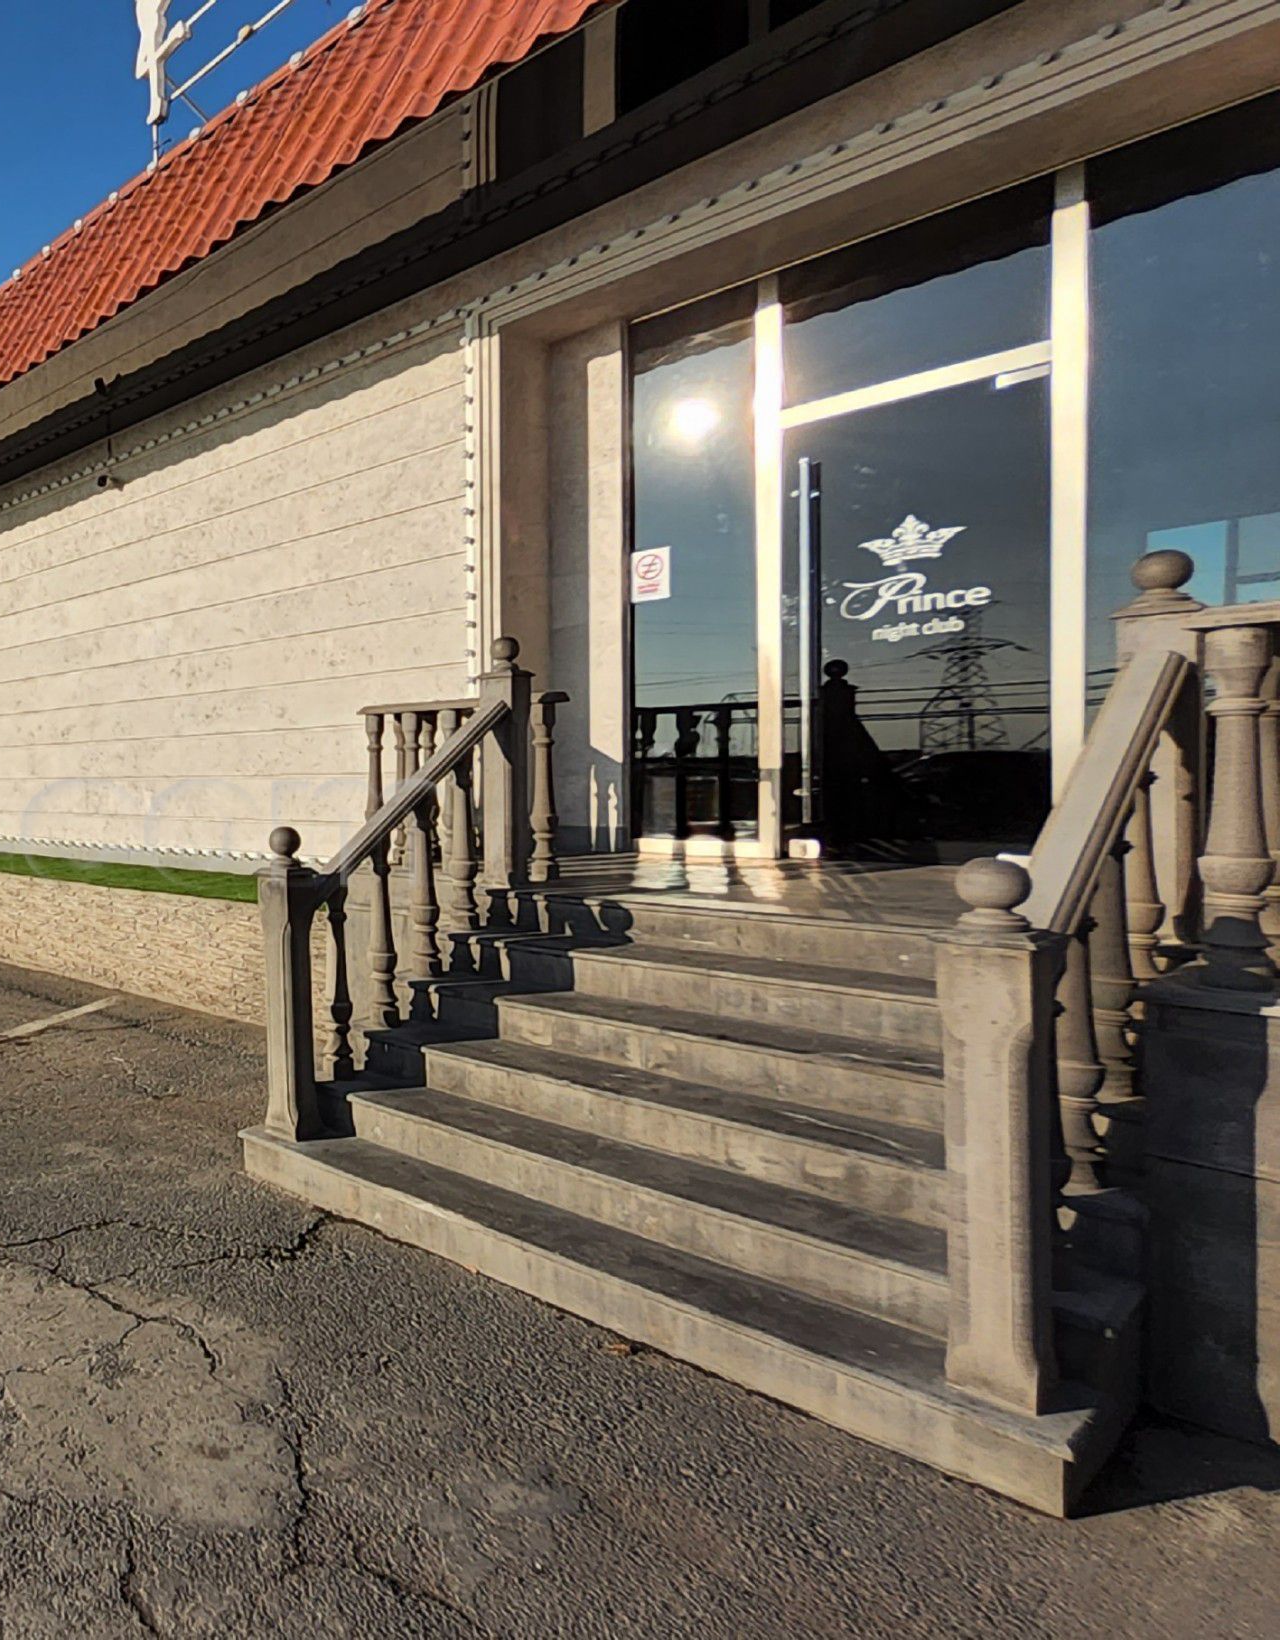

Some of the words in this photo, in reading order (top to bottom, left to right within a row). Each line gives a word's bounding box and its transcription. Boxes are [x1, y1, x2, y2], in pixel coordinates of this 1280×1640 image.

[841, 572, 992, 620] Prince
[872, 623, 920, 642] night
[922, 617, 966, 636] club
